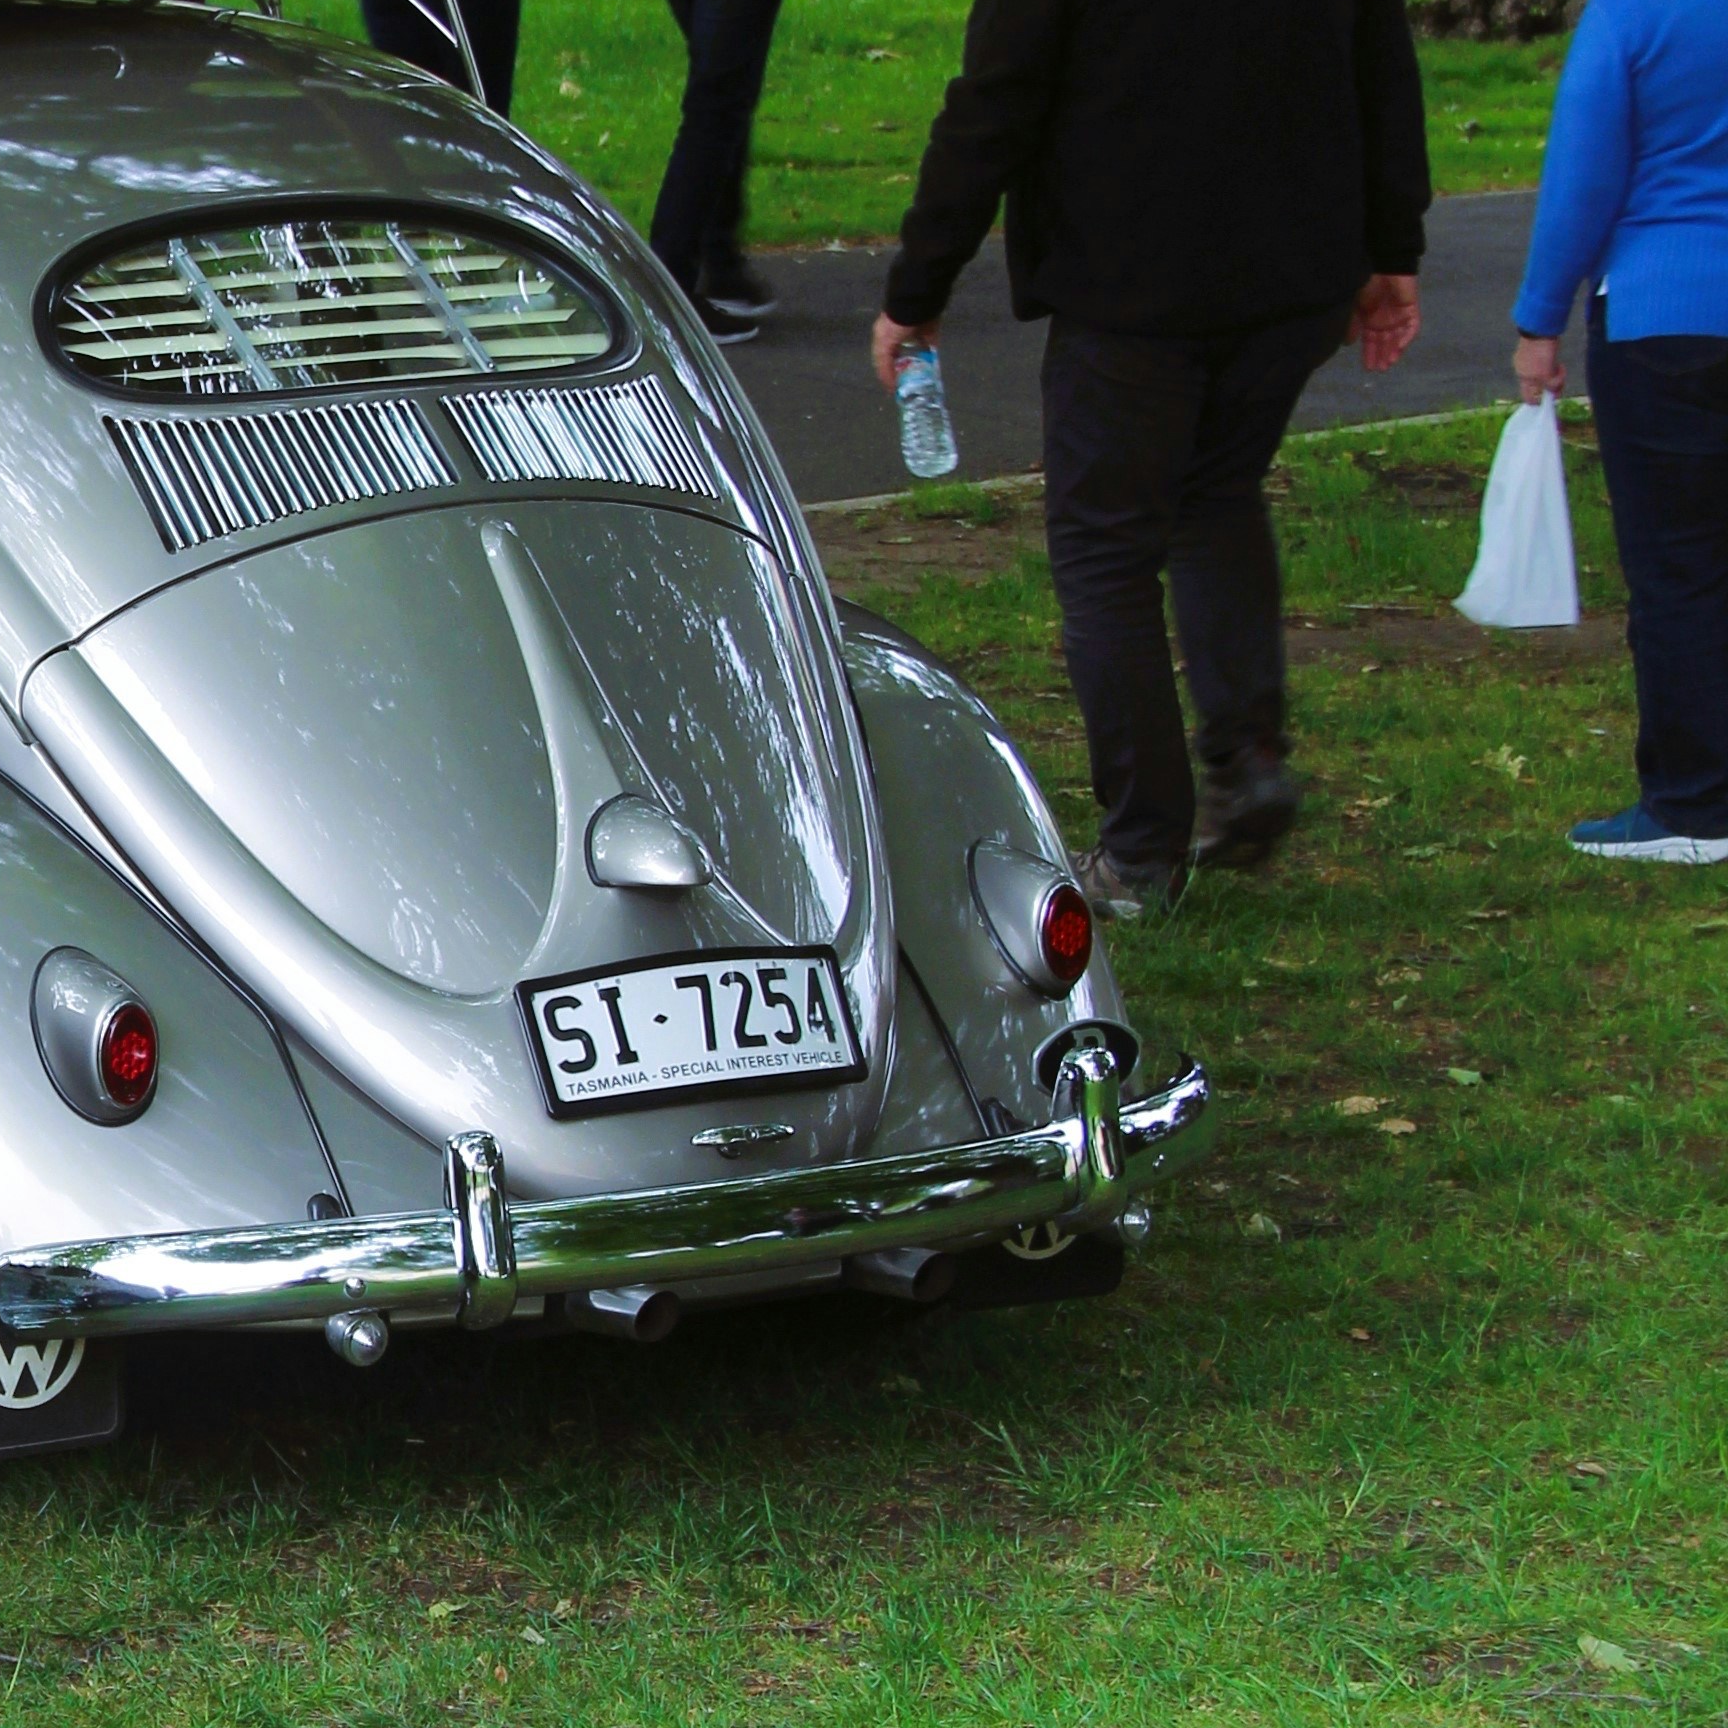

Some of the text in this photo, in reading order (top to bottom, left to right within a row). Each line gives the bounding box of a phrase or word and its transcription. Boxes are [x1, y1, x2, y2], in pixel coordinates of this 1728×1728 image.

[566, 1071, 649, 1096] TASMANIA
[660, 1058, 724, 1080] SPECIAL
[726, 1053, 790, 1071] INTEREST
[791, 1050, 843, 1066] VEHICLE
